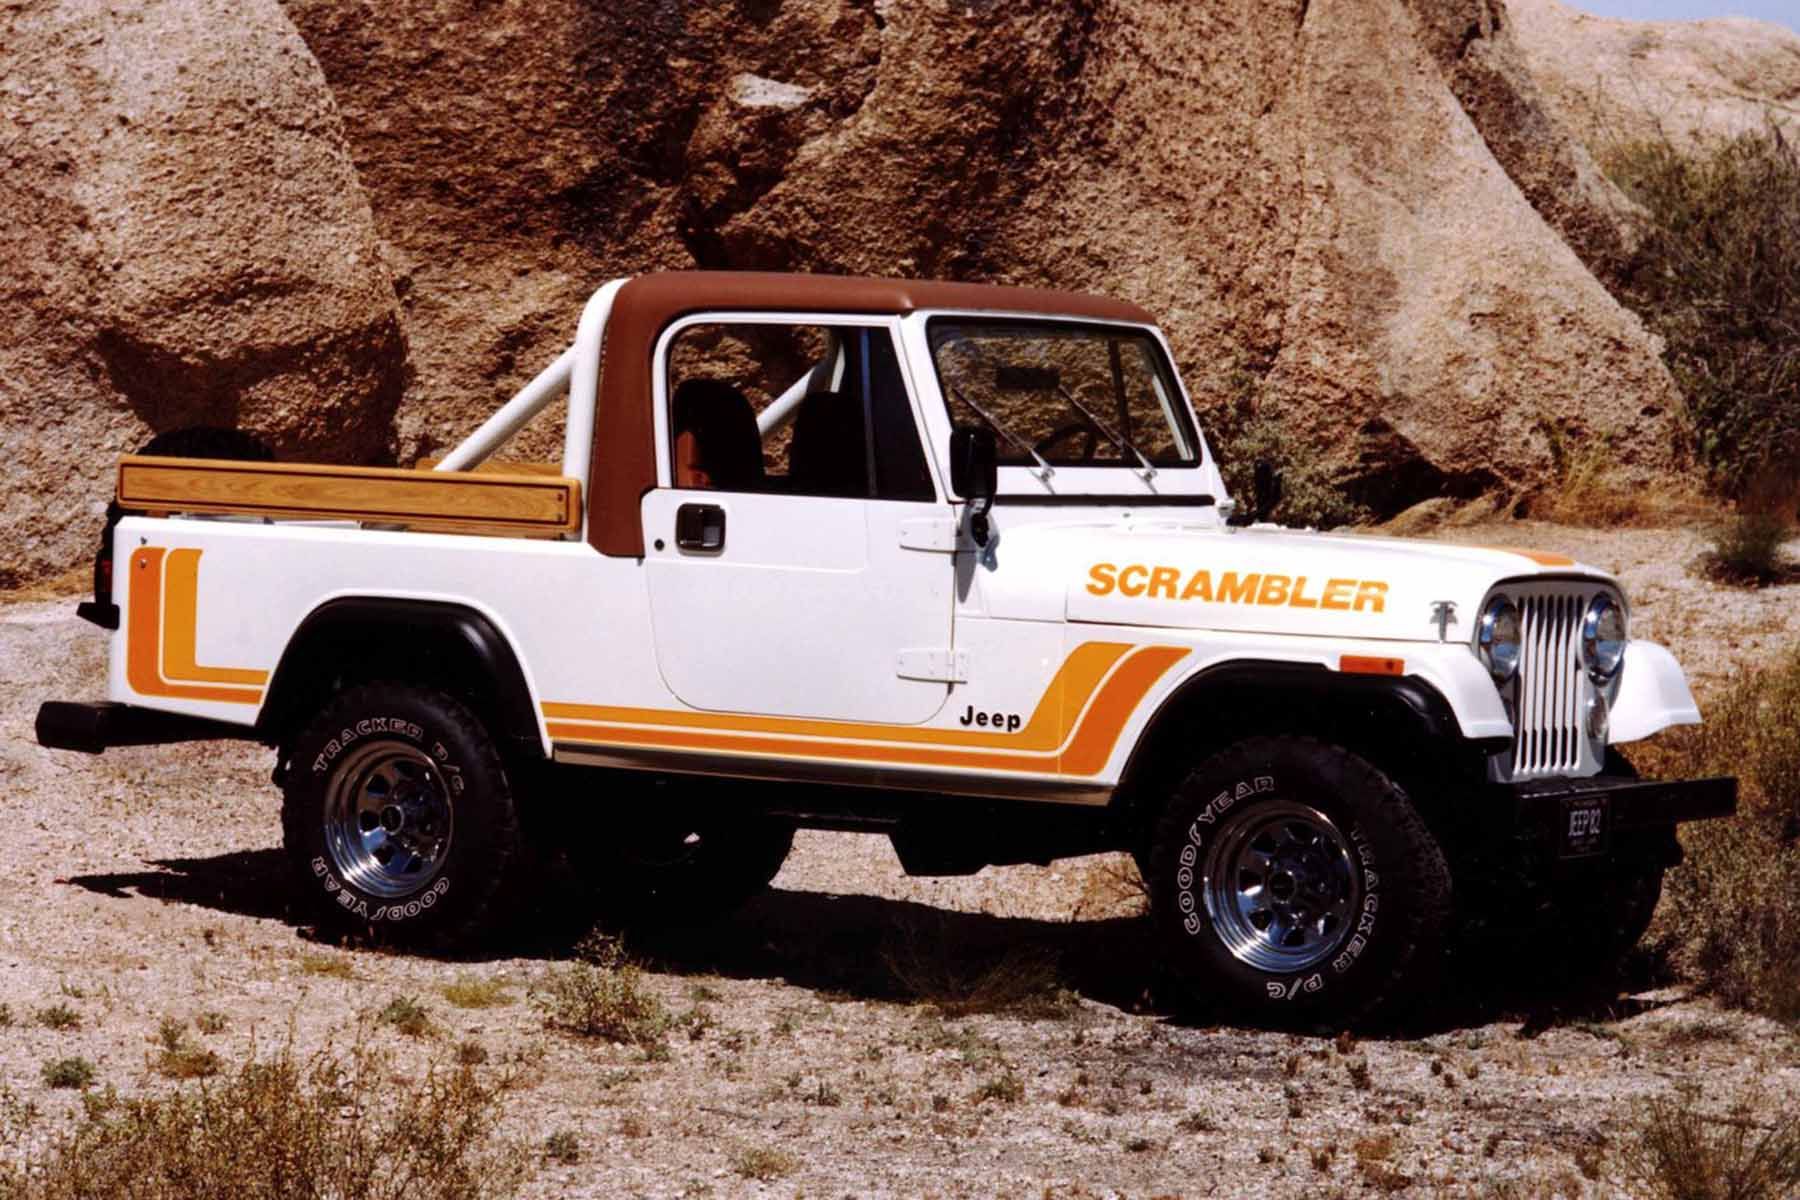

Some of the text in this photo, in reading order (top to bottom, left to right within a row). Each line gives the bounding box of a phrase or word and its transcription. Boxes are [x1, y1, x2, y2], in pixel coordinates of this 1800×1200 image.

[1086, 563, 1389, 613] SCRAMBLER
[312, 717, 424, 773] TRACKER
[960, 705, 1021, 732] Jeep
[1177, 776, 1274, 935] GOODYEAR
[311, 856, 450, 921] GOODYEAR
[1267, 821, 1379, 1000] TRACKER P/C
